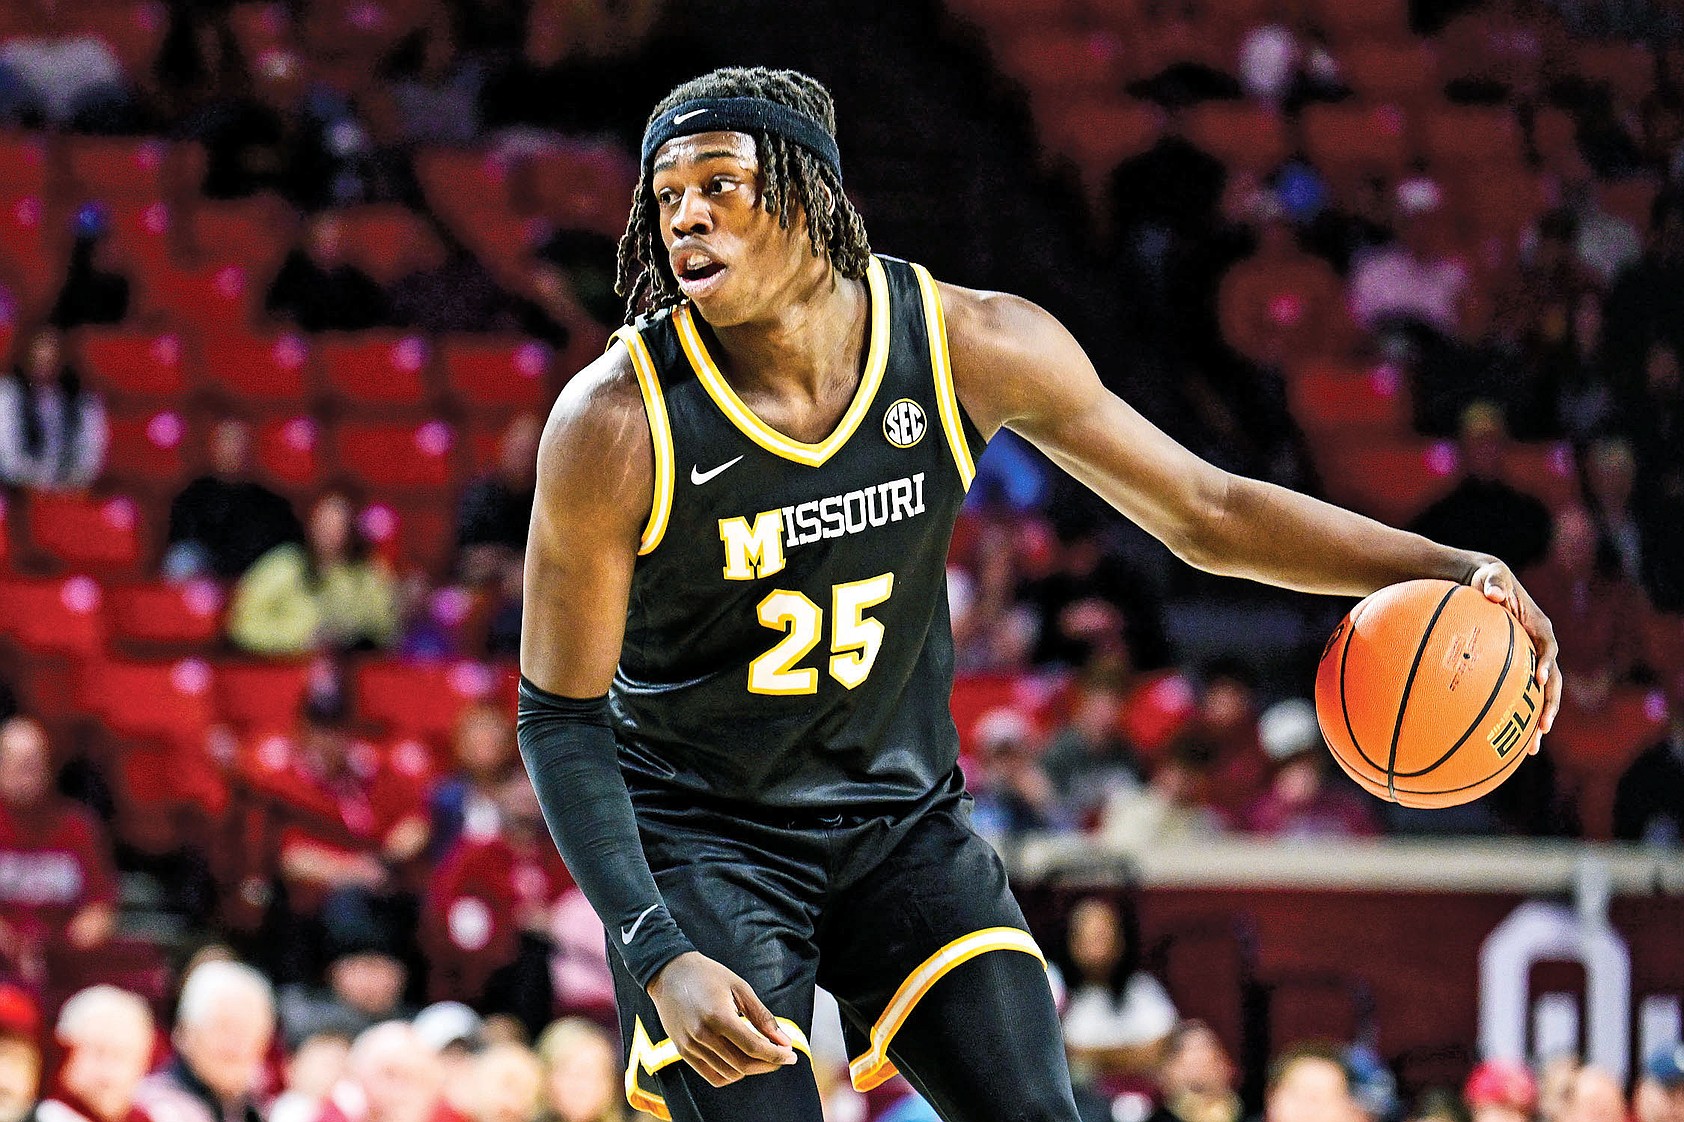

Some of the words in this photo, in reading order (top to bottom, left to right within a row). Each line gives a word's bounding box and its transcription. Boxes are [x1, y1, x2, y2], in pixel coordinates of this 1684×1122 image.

[885, 402, 924, 446] SEC
[718, 471, 926, 580] MISSOURI
[747, 571, 895, 696] 25
